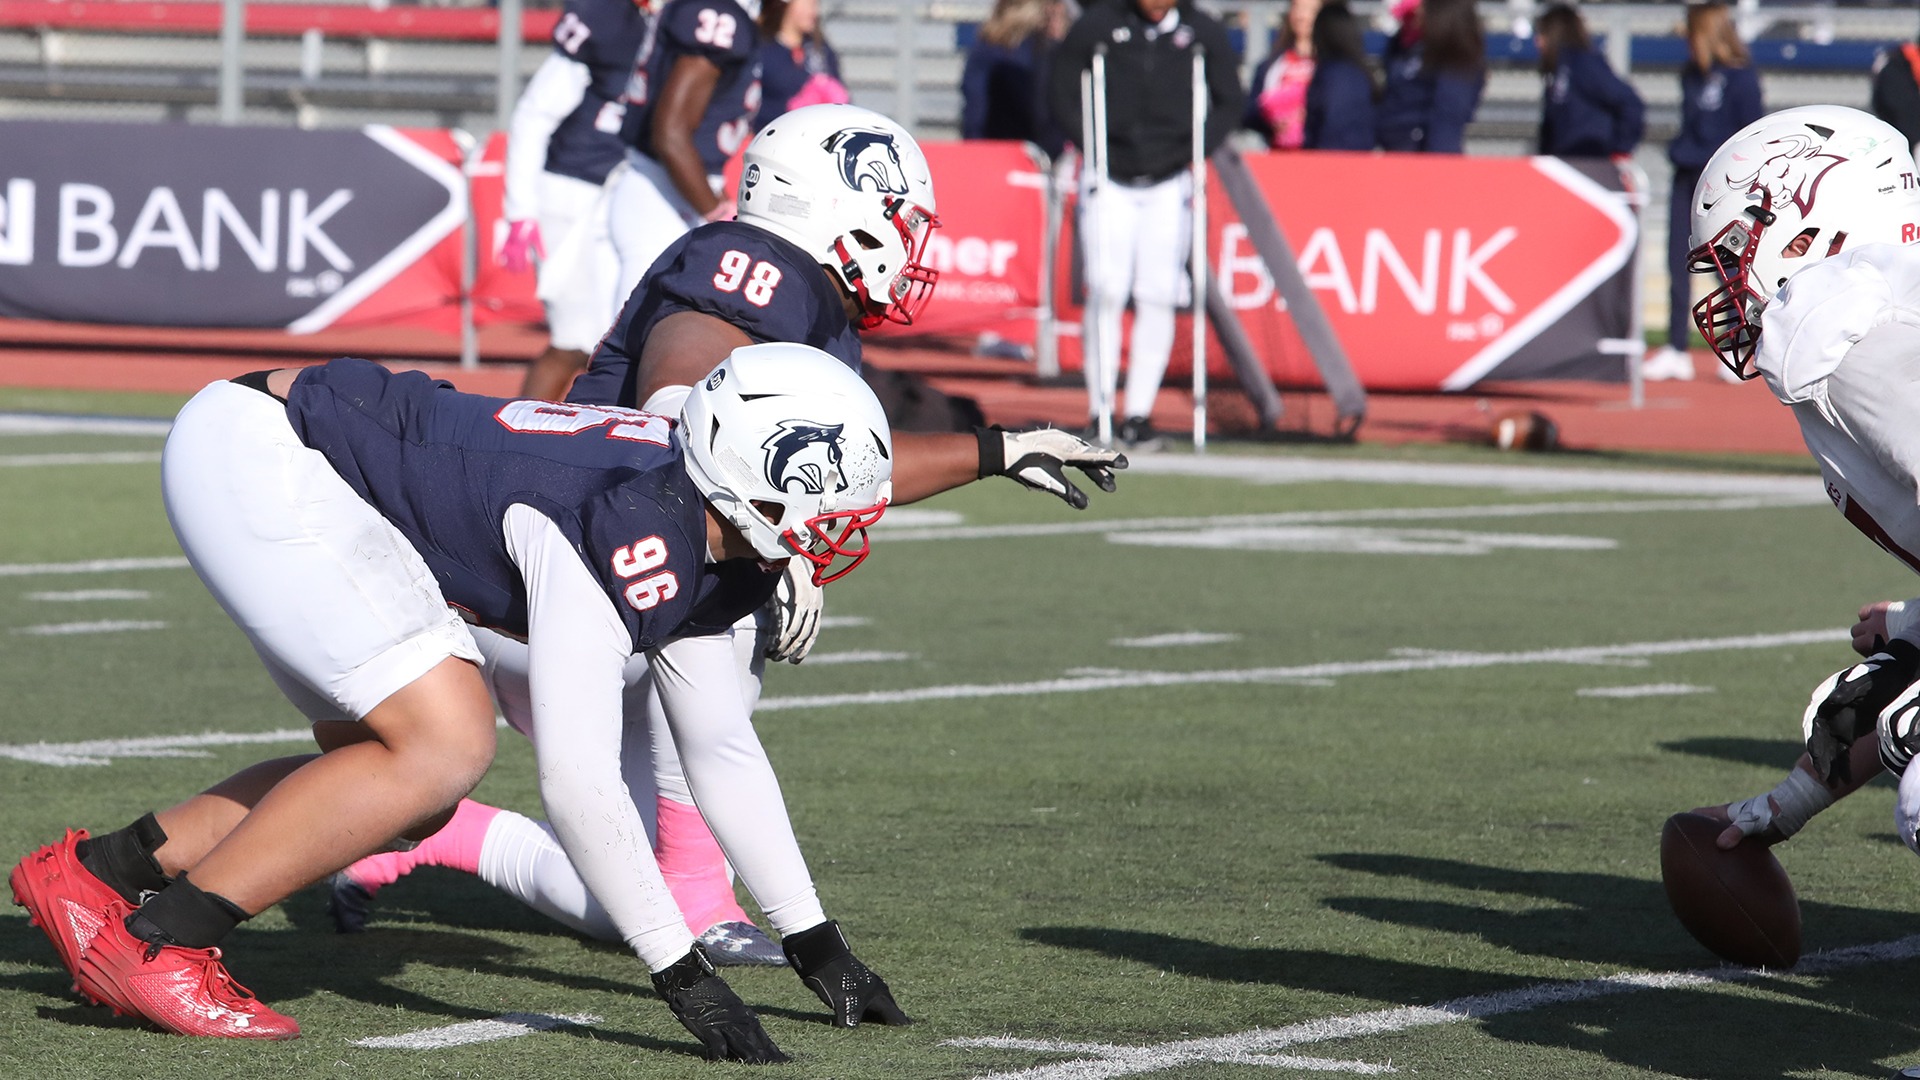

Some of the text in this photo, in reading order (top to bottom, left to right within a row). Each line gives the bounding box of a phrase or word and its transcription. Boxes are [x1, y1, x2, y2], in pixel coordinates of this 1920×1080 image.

[694, 8, 737, 49] 32
[1900, 172, 1914, 190] 77
[58, 182, 354, 273] BANK
[712, 249, 784, 309] 98
[1218, 224, 1518, 315] BANK
[611, 535, 679, 613] 96
